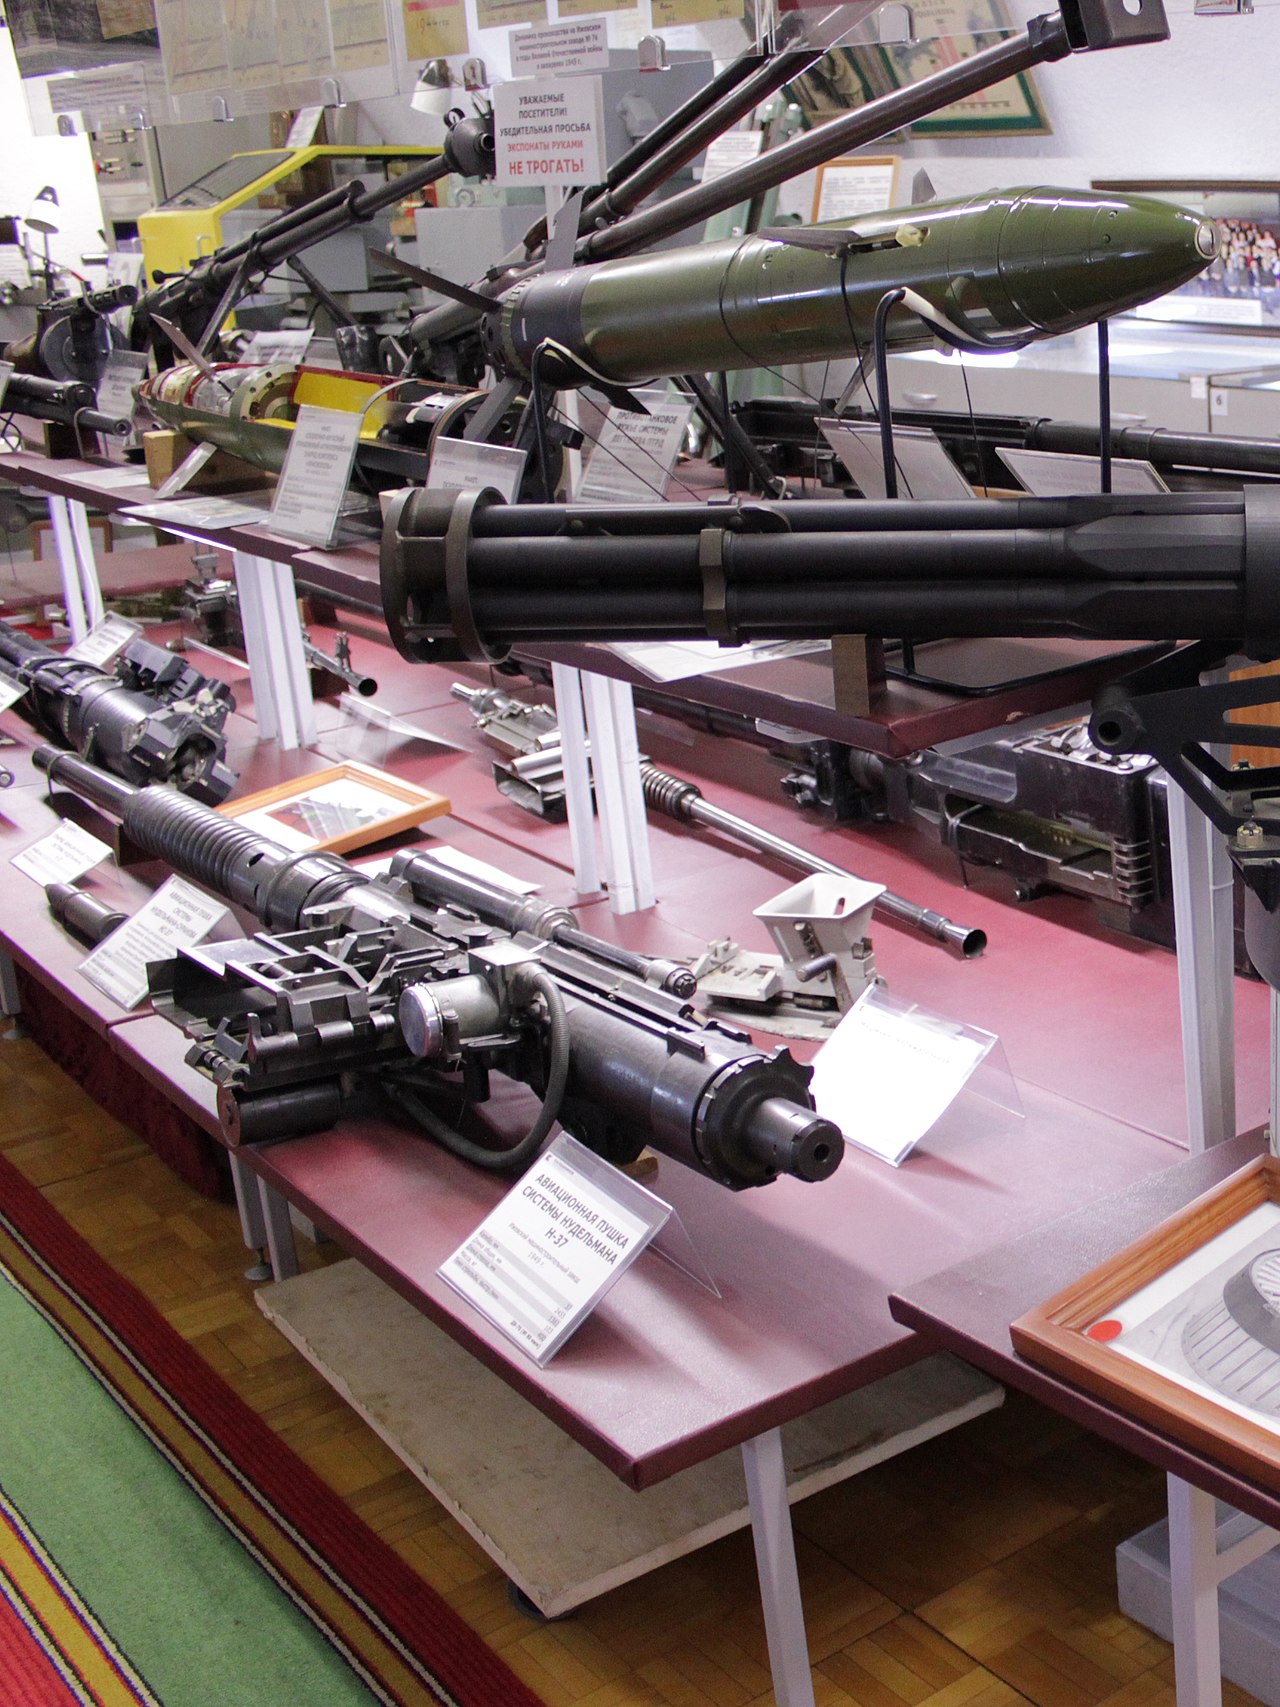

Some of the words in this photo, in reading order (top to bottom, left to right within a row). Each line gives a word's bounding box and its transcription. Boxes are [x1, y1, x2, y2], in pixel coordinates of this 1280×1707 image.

[519, 93, 564, 105] УВАЖАЕМЫЕ
[519, 107, 567, 119] ПОСЕТИТЕЛИ!
[500, 125, 552, 136] УБЕДИТЕЛЬНАЯ
[555, 122, 591, 133] ПРОСЬБА
[507, 142, 549, 152] ЭКСПОНАТЫ
[552, 140, 584, 149] РУКАМИ
[509, 160, 523, 175] НЕ
[526, 158, 584, 175] ТРОГАТЬ!
[535, 1173, 599, 1225] АВИАЦИОННАЯ
[595, 1219, 629, 1249] ПУШКА
[522, 1185, 562, 1221] СИСТЕМЫ
[560, 1215, 618, 1265] НУДЕЛЬМАНА
[545, 1227, 568, 1248] Н-37
